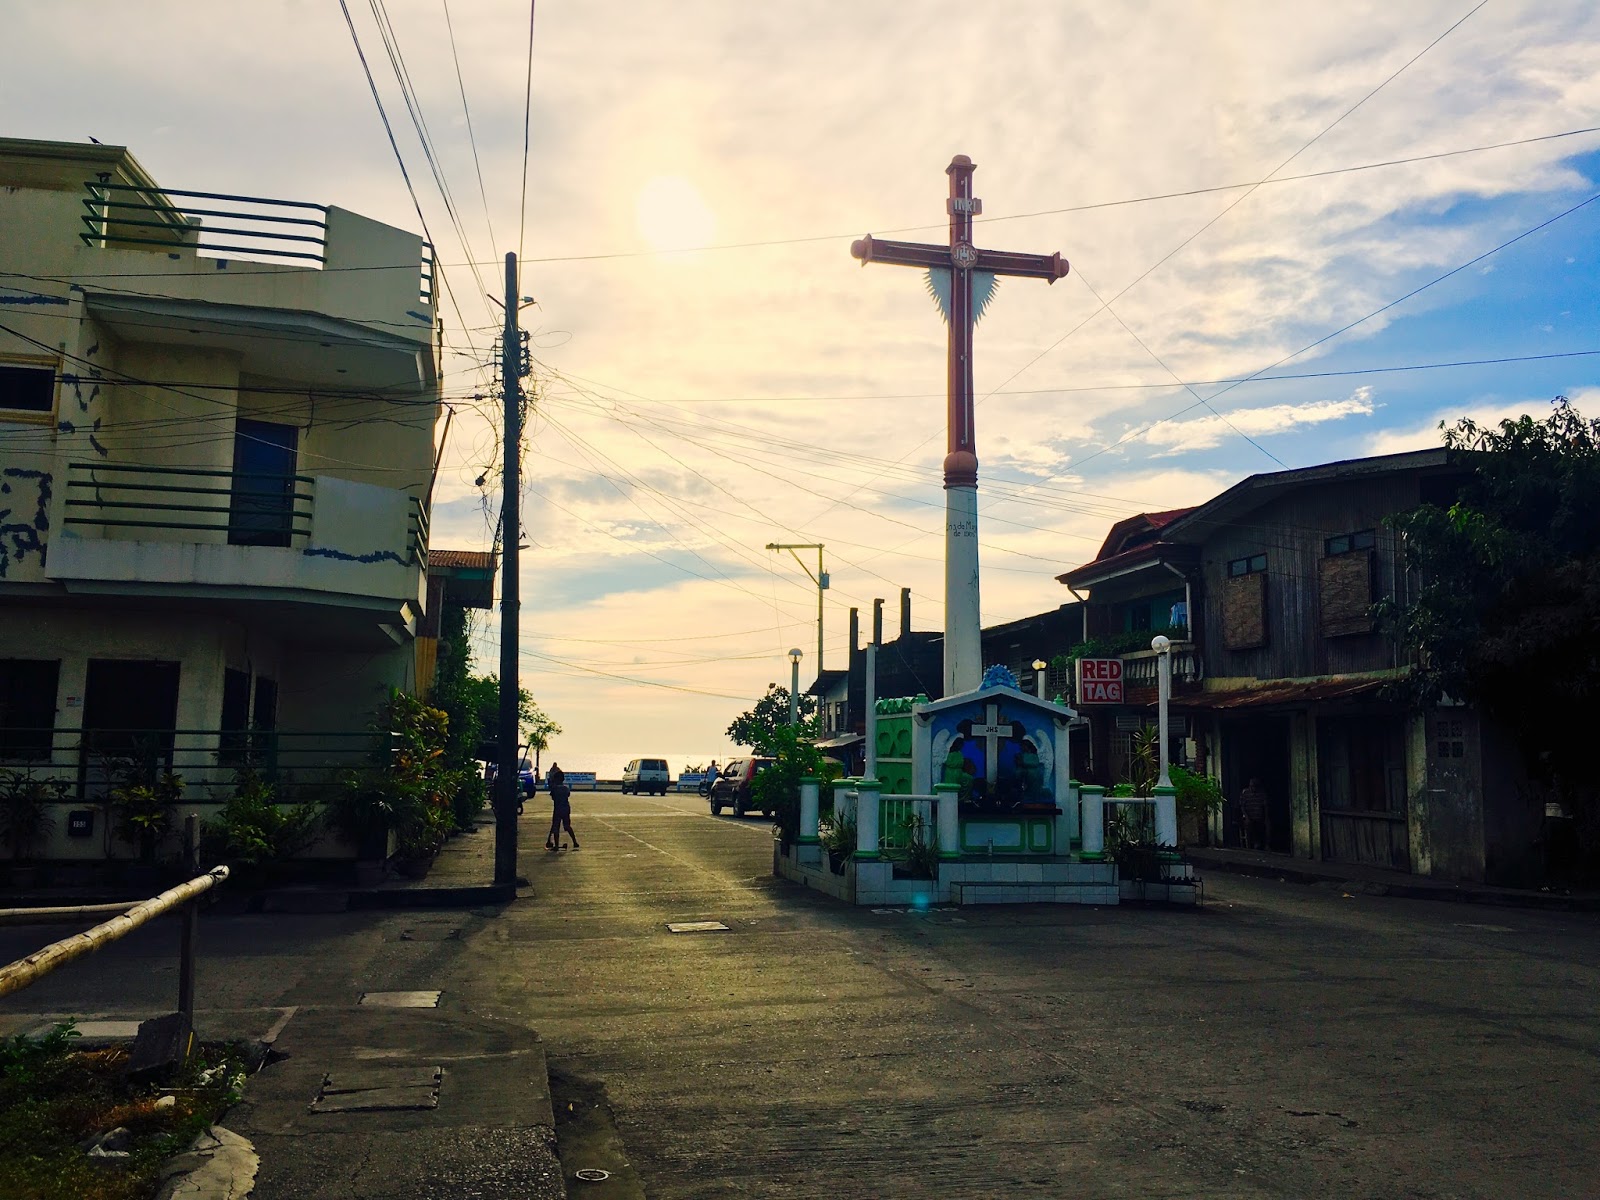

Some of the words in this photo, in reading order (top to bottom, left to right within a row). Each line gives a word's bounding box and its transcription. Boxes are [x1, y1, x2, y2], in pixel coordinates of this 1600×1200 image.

[954, 199, 976, 212] INRI
[1082, 660, 1122, 679] RED
[1084, 683, 1120, 700] TAG
